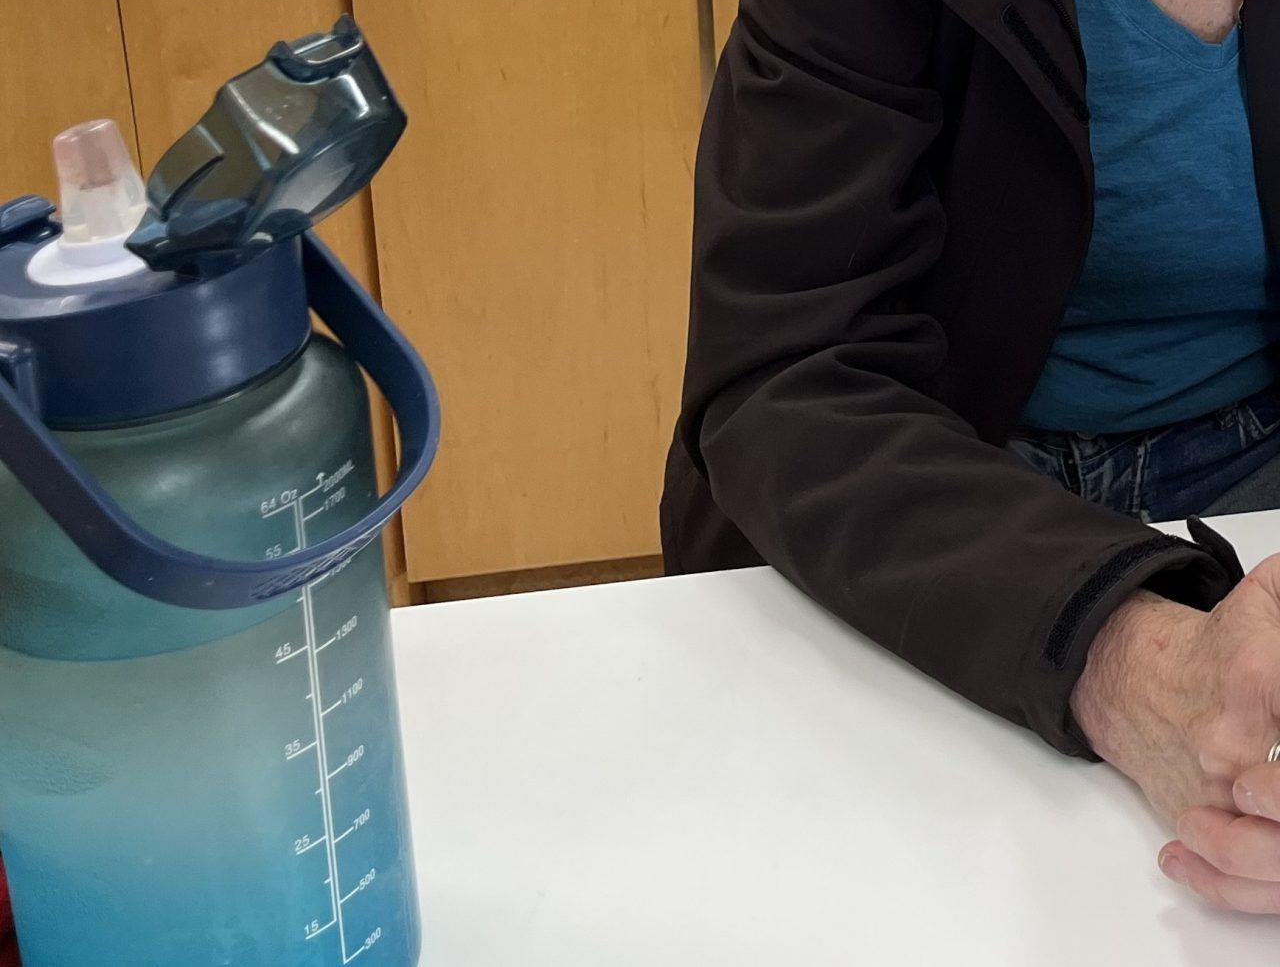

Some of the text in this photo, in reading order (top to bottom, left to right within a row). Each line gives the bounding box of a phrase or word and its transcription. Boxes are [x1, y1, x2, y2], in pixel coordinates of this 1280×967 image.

[260, 498, 276, 514] 64
[336, 615, 358, 640] 1300
[275, 642, 291, 659] 45
[341, 678, 363, 704] 1100
[284, 739, 301, 756] 35
[347, 745, 364, 767] 900
[353, 808, 370, 831] 700
[294, 834, 310, 852] 25
[359, 868, 376, 891] 500
[304, 919, 319, 935] 15
[364, 927, 382, 950] 300
